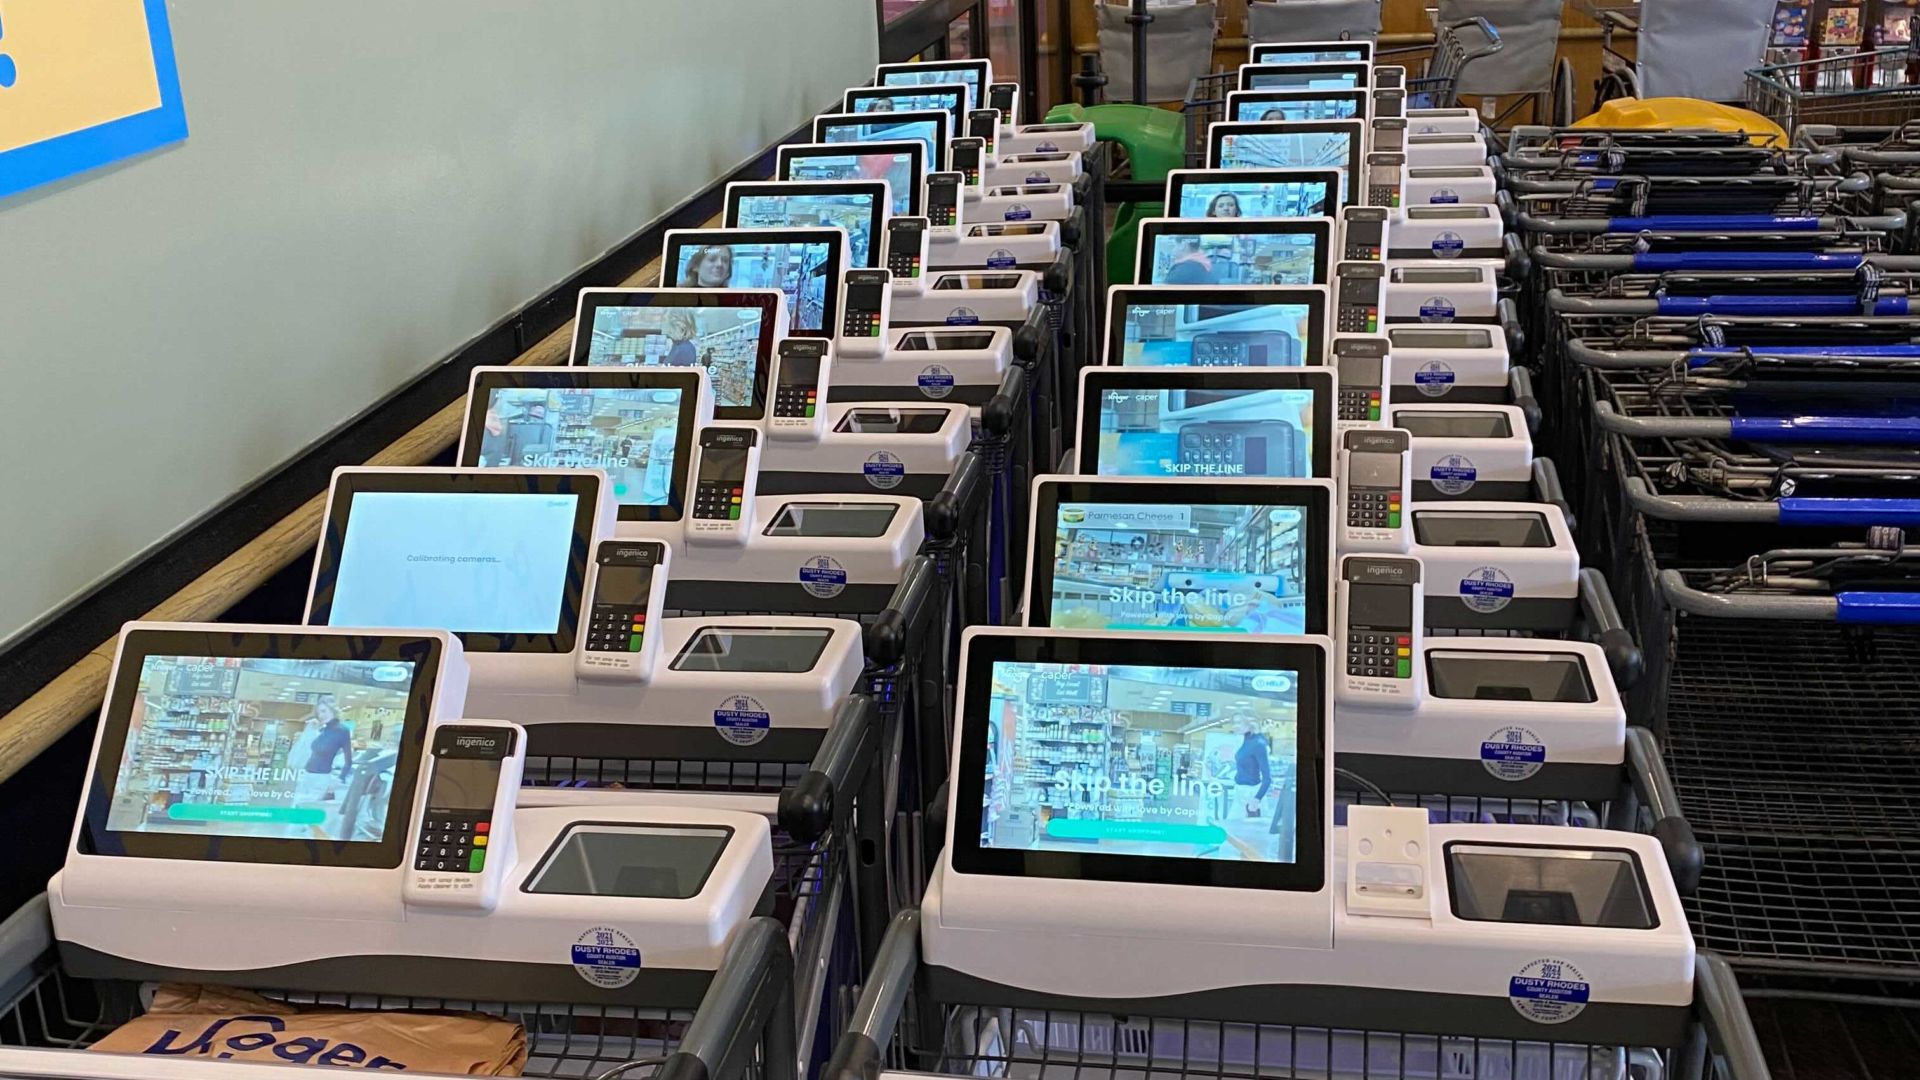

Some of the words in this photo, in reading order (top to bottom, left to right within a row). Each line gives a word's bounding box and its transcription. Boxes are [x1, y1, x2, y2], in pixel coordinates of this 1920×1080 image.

[1135, 393, 1159, 402] caper
[523, 453, 559, 469] Skip
[598, 454, 628, 468] line
[1165, 463, 1191, 473] SKIP
[1192, 463, 1216, 474] THE
[1217, 463, 1244, 474] LINE
[1088, 512, 1135, 520] Parmesan
[1137, 512, 1173, 521] Cheese
[406, 555, 456, 565] Calibrating
[1367, 565, 1403, 576] ingenico
[1109, 586, 1156, 608] Skip
[1162, 586, 1200, 605] the
[1205, 588, 1247, 606] line
[186, 662, 215, 673] caper
[1041, 671, 1073, 681] caper
[456, 736, 496, 748] ingenico
[206, 765, 238, 780] SKIP
[242, 766, 271, 781] THE
[1054, 769, 1111, 798] Skip
[1119, 772, 1165, 795] the
[1172, 773, 1224, 797] line
[250, 789, 270, 798] love
[271, 789, 282, 800] by
[1068, 802, 1112, 812] Powered
[1159, 806, 1173, 817] by
[574, 945, 601, 953] DUSTY
[603, 947, 637, 956] RHODES
[1514, 977, 1546, 987] DUSTY
[1547, 980, 1587, 991] RHODES
[142, 1015, 407, 1071] Koger
